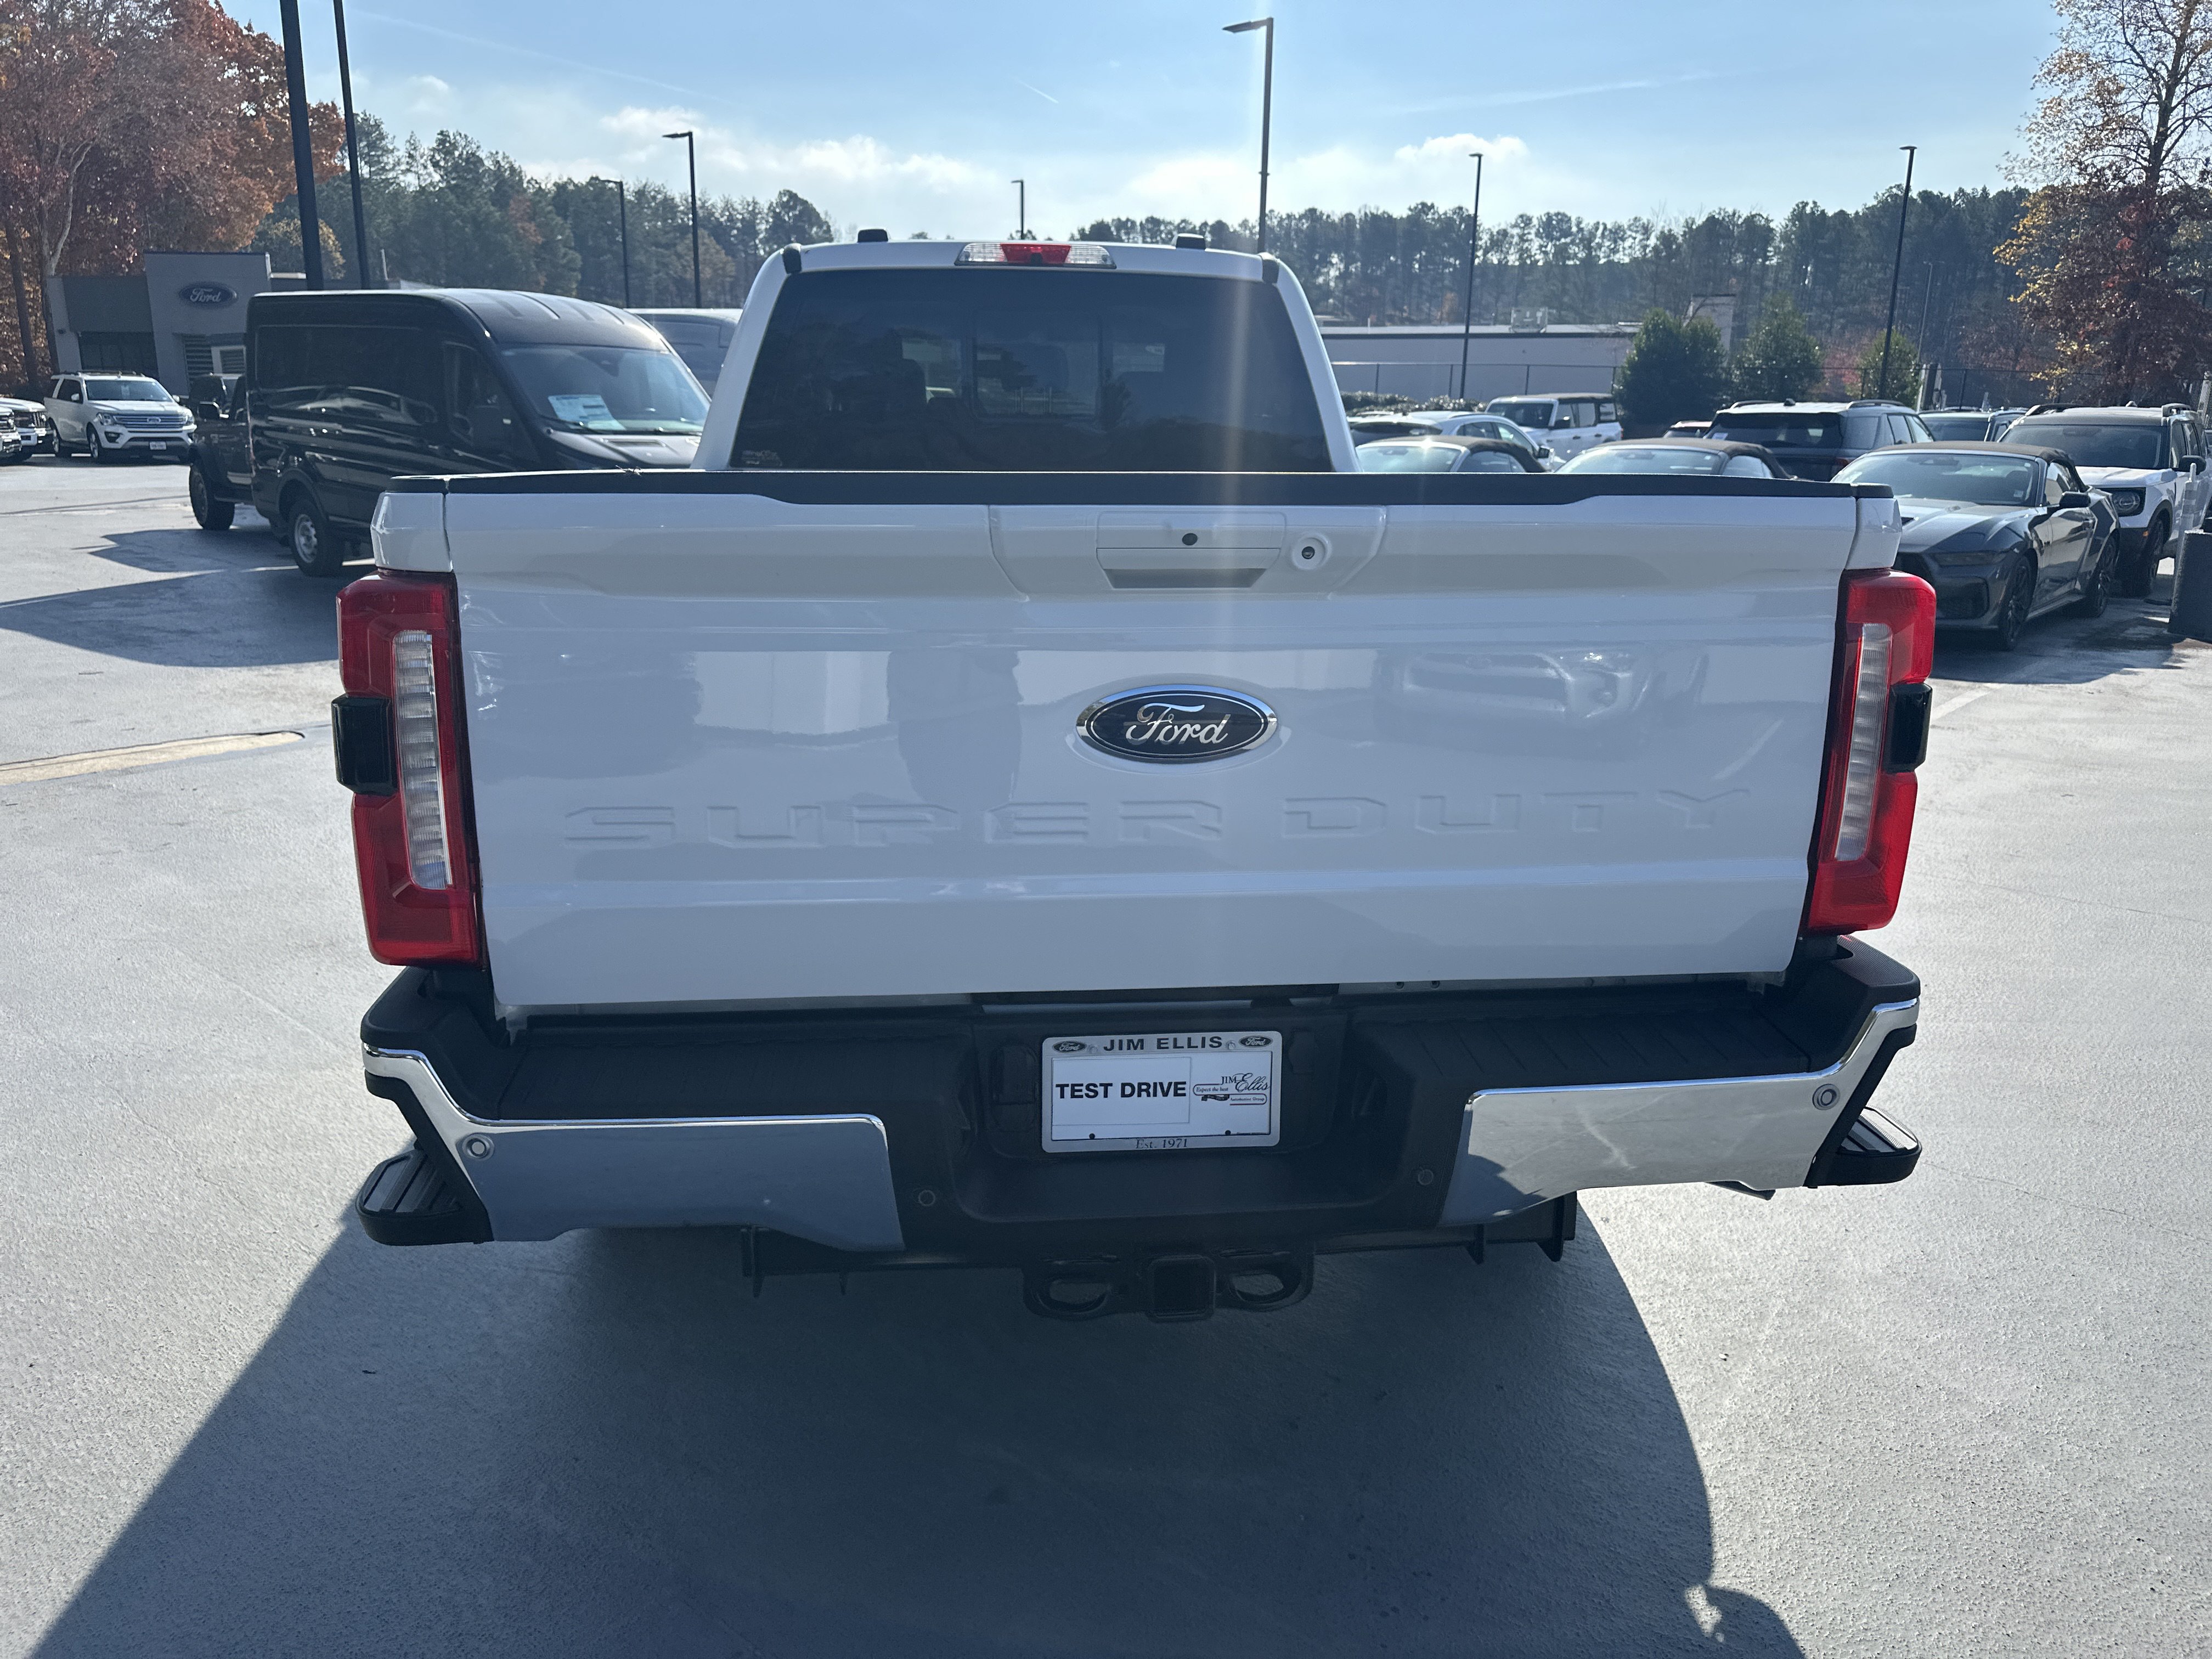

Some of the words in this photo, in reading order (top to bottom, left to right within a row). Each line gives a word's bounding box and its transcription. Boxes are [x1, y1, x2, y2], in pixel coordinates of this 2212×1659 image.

[190, 288, 221, 302] Ford
[1126, 702, 1231, 745] Ford
[564, 799, 1222, 848] SUPER
[1281, 788, 1751, 839] DUTY
[1059, 1042, 1080, 1051] Ford
[1103, 1039, 1144, 1051] JIM
[1156, 1036, 1222, 1049] ELLIS
[1245, 1037, 1266, 1046] Ford
[1056, 1082, 1113, 1099] TEST
[1121, 1081, 1187, 1098] DRIVE
[1221, 1076, 1237, 1085] JIM
[1232, 1073, 1270, 1092] Ellis
[1135, 1138, 1157, 1149] Est.
[1163, 1138, 1187, 1148] 1971
